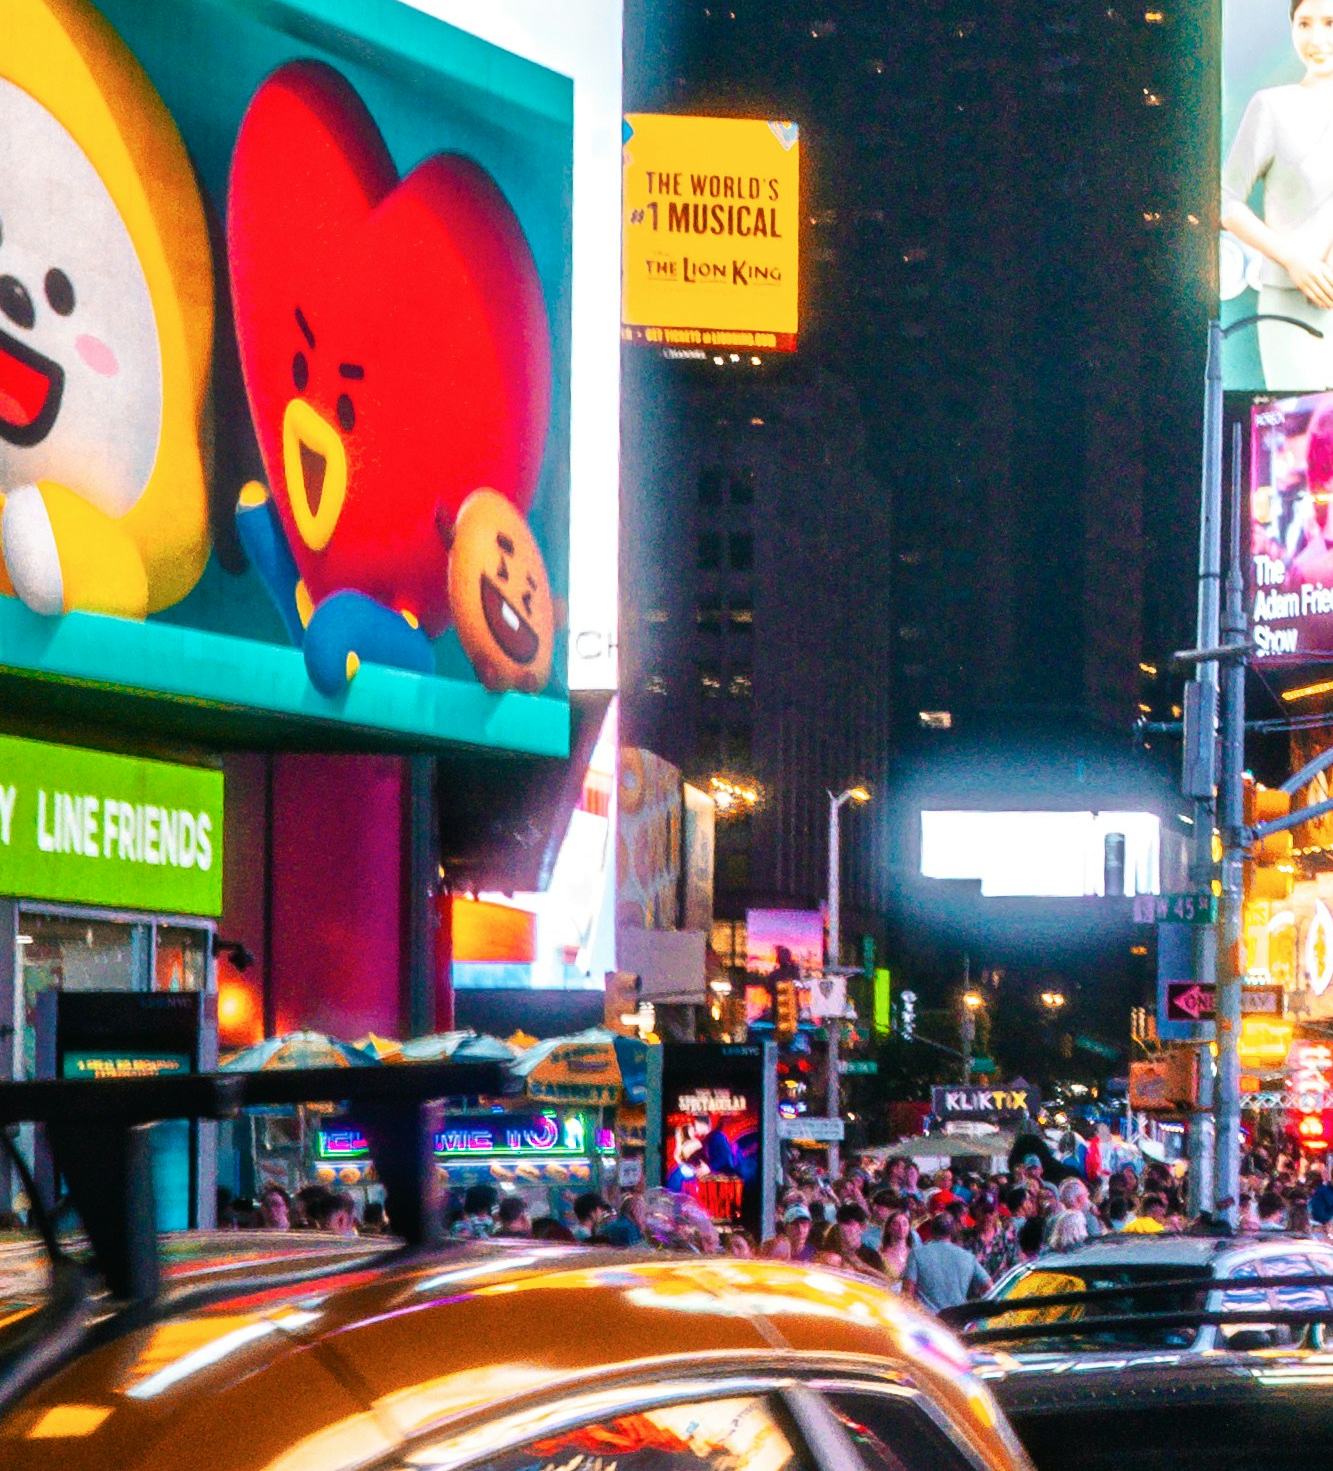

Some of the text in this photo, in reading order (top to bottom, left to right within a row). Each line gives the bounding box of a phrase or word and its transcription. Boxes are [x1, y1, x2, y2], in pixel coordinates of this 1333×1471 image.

[645, 171, 779, 201] THE WORLD'S
[630, 201, 781, 238] #1 MUSICAL
[646, 259, 677, 275] THE
[1253, 555, 1285, 587] The
[1253, 590, 1299, 622] Adam
[1253, 625, 1298, 653] Show
[37, 788, 99, 858] LINE
[103, 797, 212, 872] FRIENDS
[1155, 897, 1169, 920] W
[1173, 896, 1195, 920] 45
